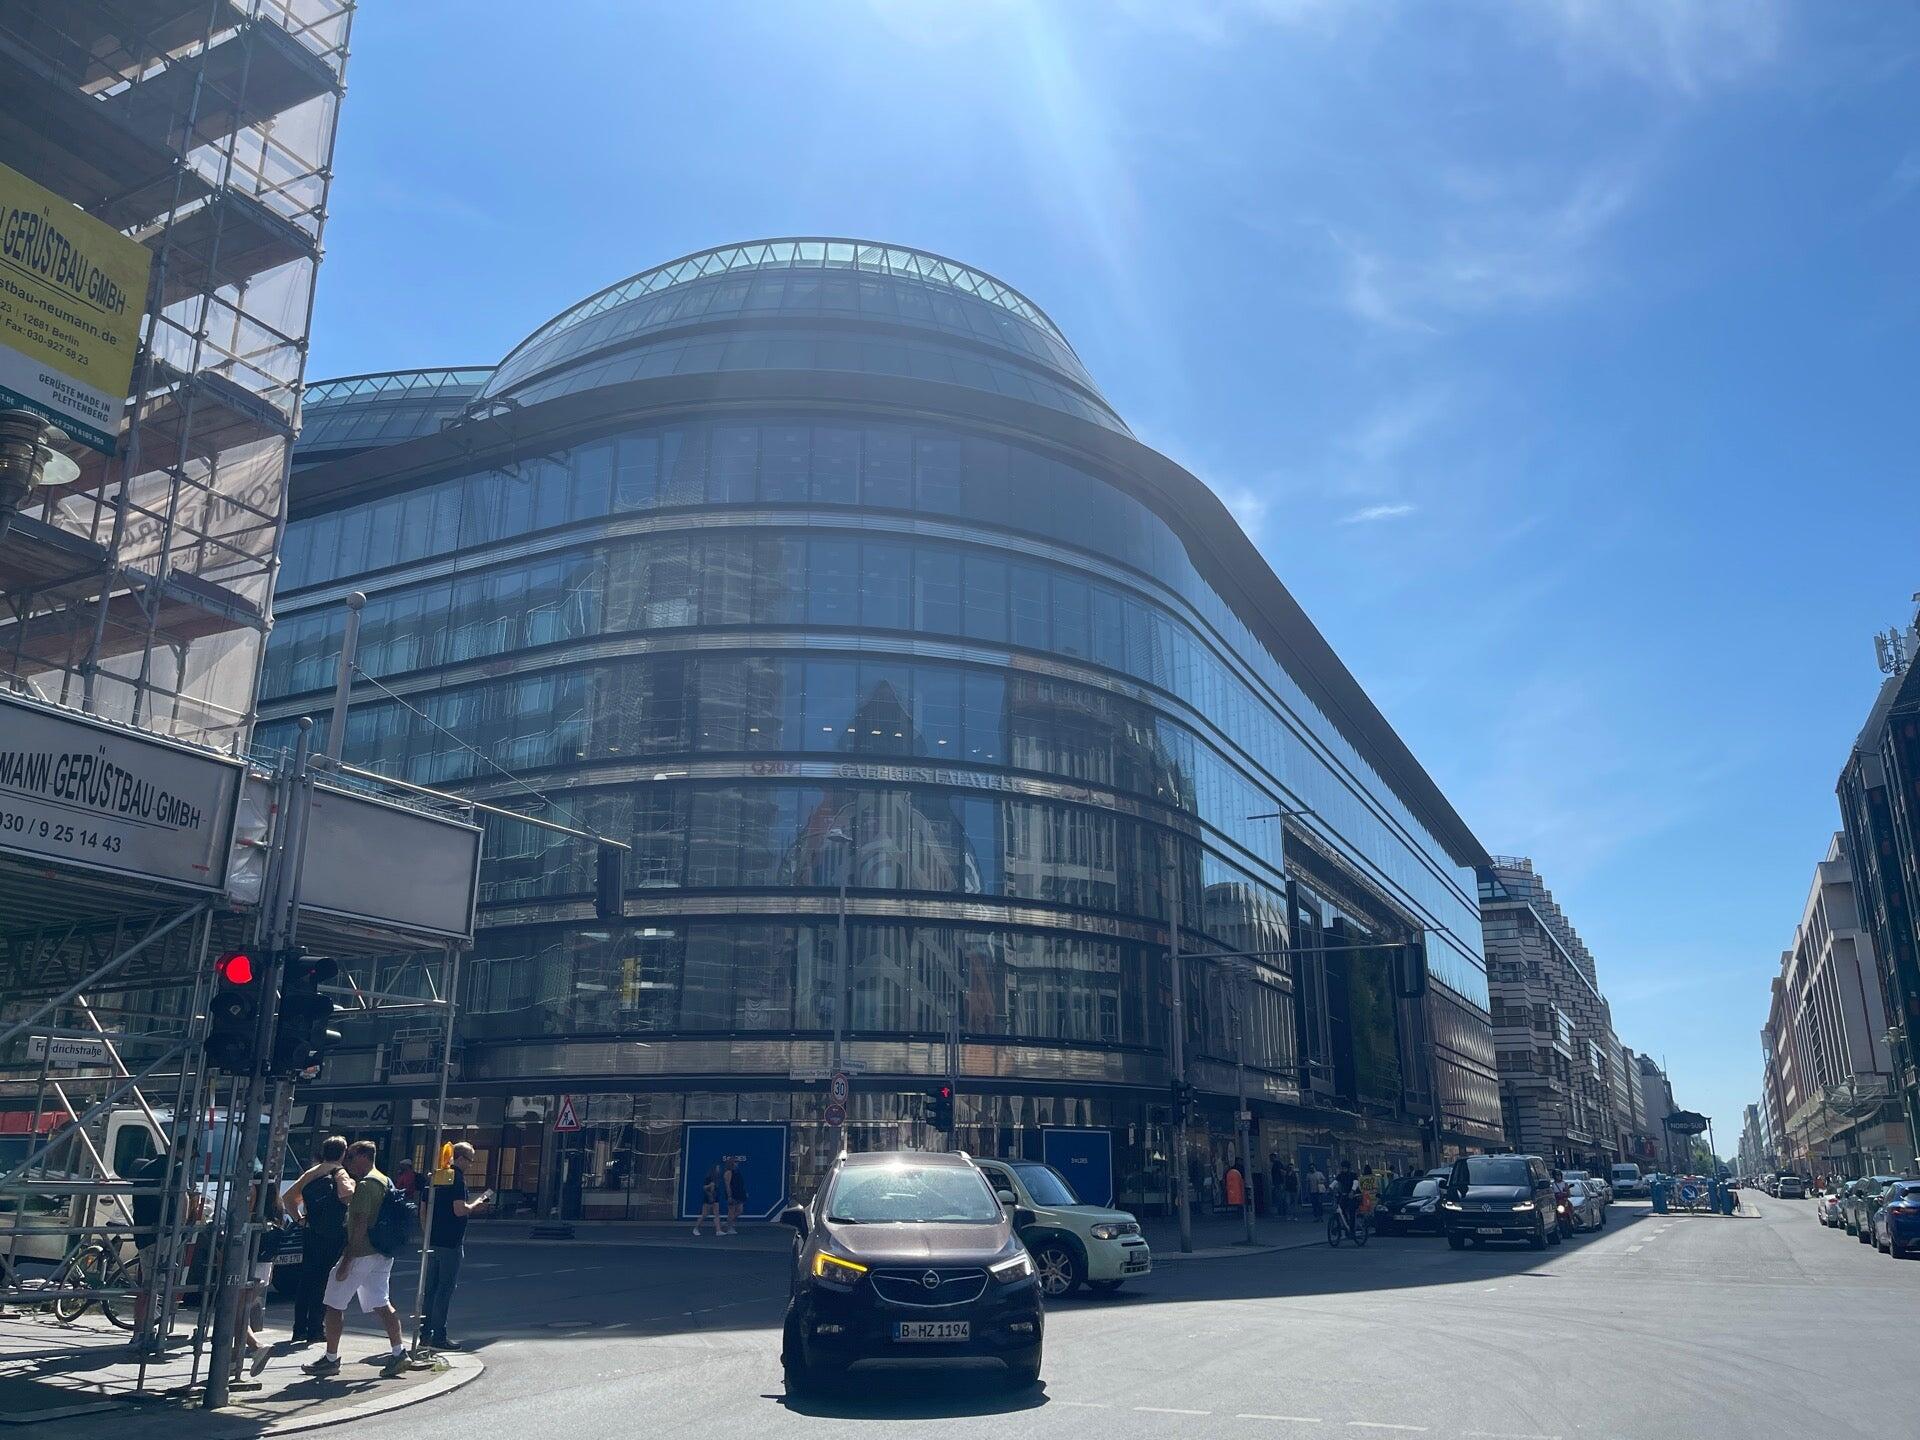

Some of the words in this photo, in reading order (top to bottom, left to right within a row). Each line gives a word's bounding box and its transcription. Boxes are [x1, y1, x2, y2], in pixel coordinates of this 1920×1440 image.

[3, 206, 88, 293] GERÜSTBAU
[88, 267, 126, 315] GMBH
[5, 318, 26, 335] Fax:
[52, 327, 80, 347] Berlin
[39, 373, 75, 396] GERÜSTE
[77, 391, 99, 408] MADE
[101, 401, 111, 412] IN
[52, 391, 109, 423] PLETTENBERG
[0, 752, 53, 793] MANN
[53, 745, 155, 819] GERÜSTBAU
[156, 791, 201, 830] GMBH
[39, 821, 49, 837] 9
[53, 824, 74, 843] 25
[80, 830, 98, 848] 14
[102, 835, 121, 853] 43
[36, 1042, 102, 1057] Frdrichstraße
[834, 1081, 845, 1096] 30
[938, 1323, 968, 1337] 1194
